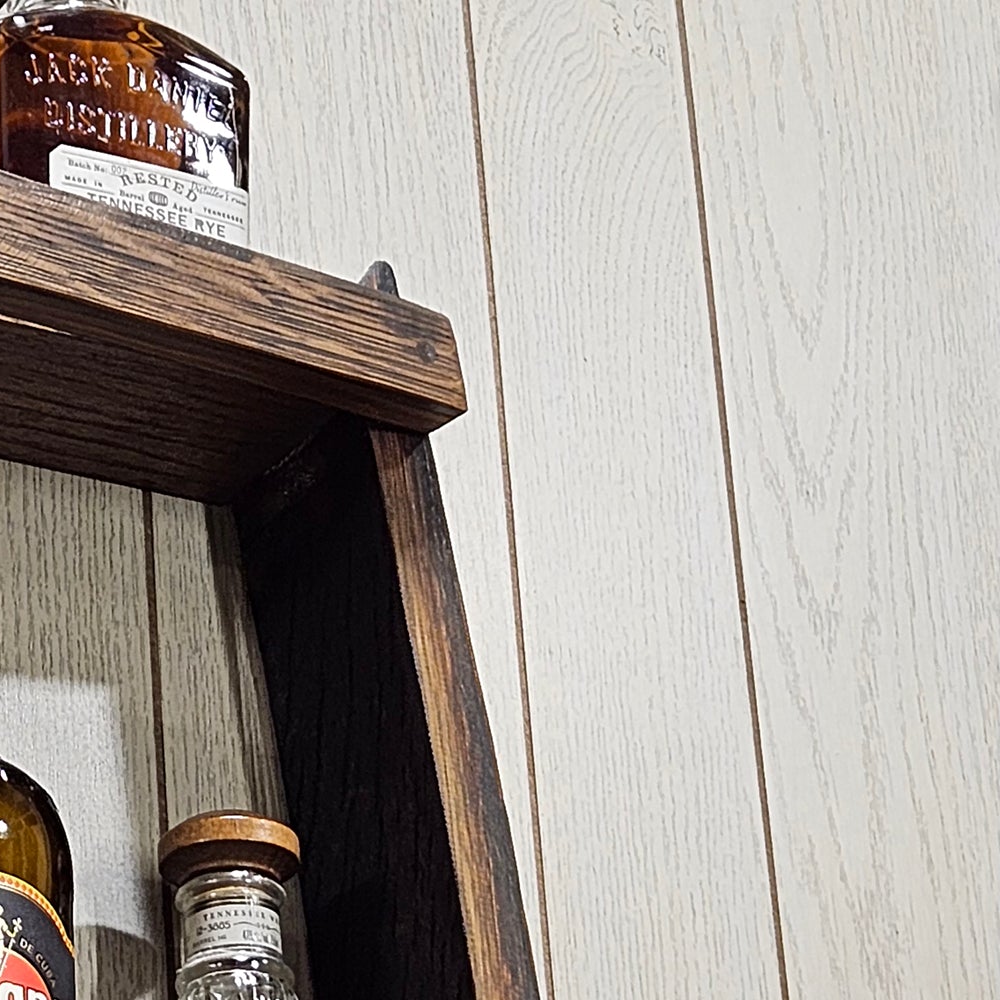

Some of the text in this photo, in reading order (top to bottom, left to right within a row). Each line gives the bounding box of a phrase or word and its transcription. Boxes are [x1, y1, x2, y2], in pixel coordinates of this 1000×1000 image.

[24, 52, 113, 89] JACK
[66, 157, 91, 171] Batch
[64, 174, 87, 185] MADE
[119, 171, 199, 203] RESTED
[118, 188, 146, 203] Barrel
[194, 216, 227, 239] RYE
[19, 937, 35, 954] DE
